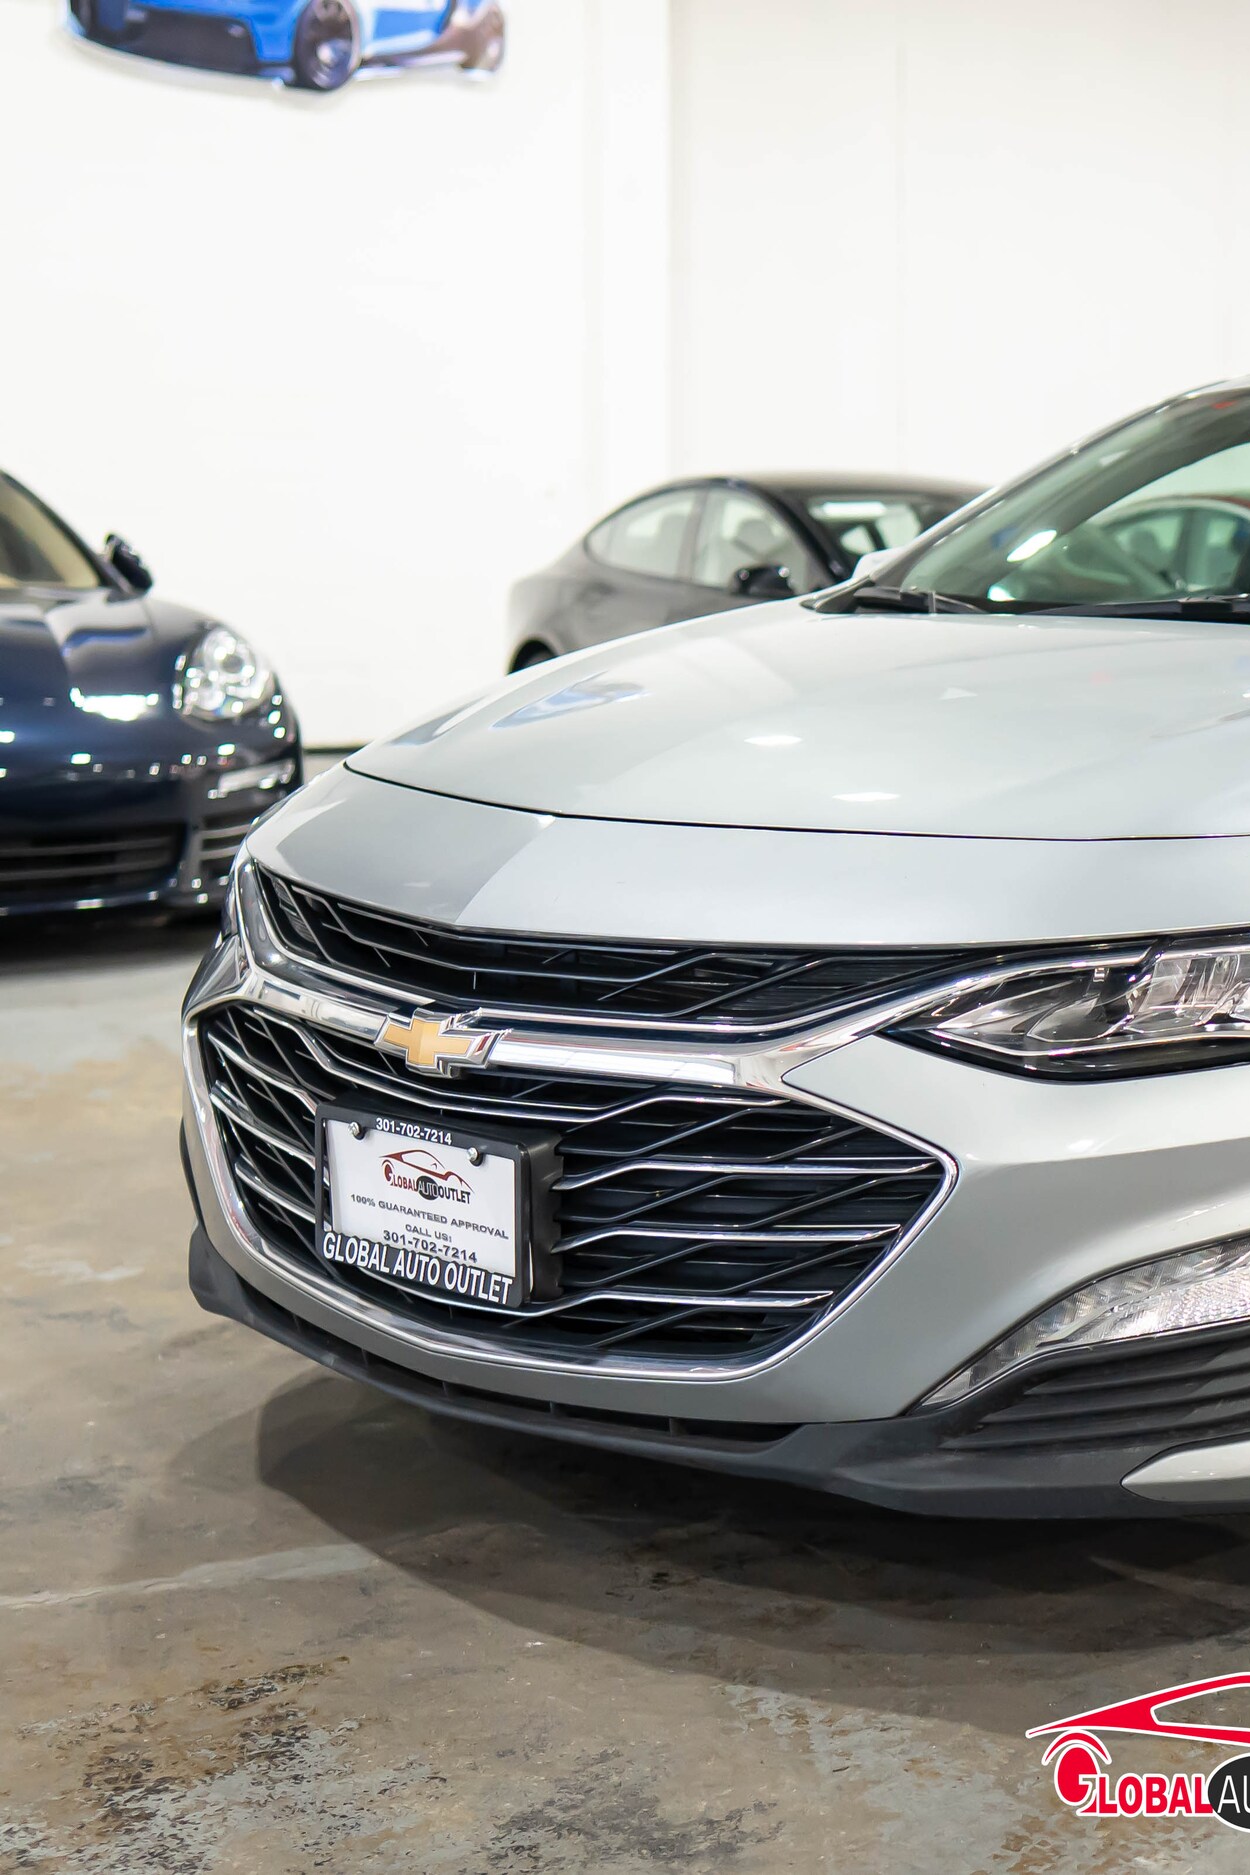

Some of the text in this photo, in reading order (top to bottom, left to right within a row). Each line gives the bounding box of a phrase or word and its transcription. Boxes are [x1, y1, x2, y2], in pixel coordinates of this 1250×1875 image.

[375, 1117, 452, 1146] 301-702-7214
[438, 1186, 471, 1205] OUTLET
[350, 1194, 509, 1240] 100% GUARANTEED APPROVAL
[383, 1229, 478, 1264] 301-702-7214
[405, 1224, 452, 1243] CALL US:
[322, 1231, 513, 1305] GLOBAL AUTO OUTLET
